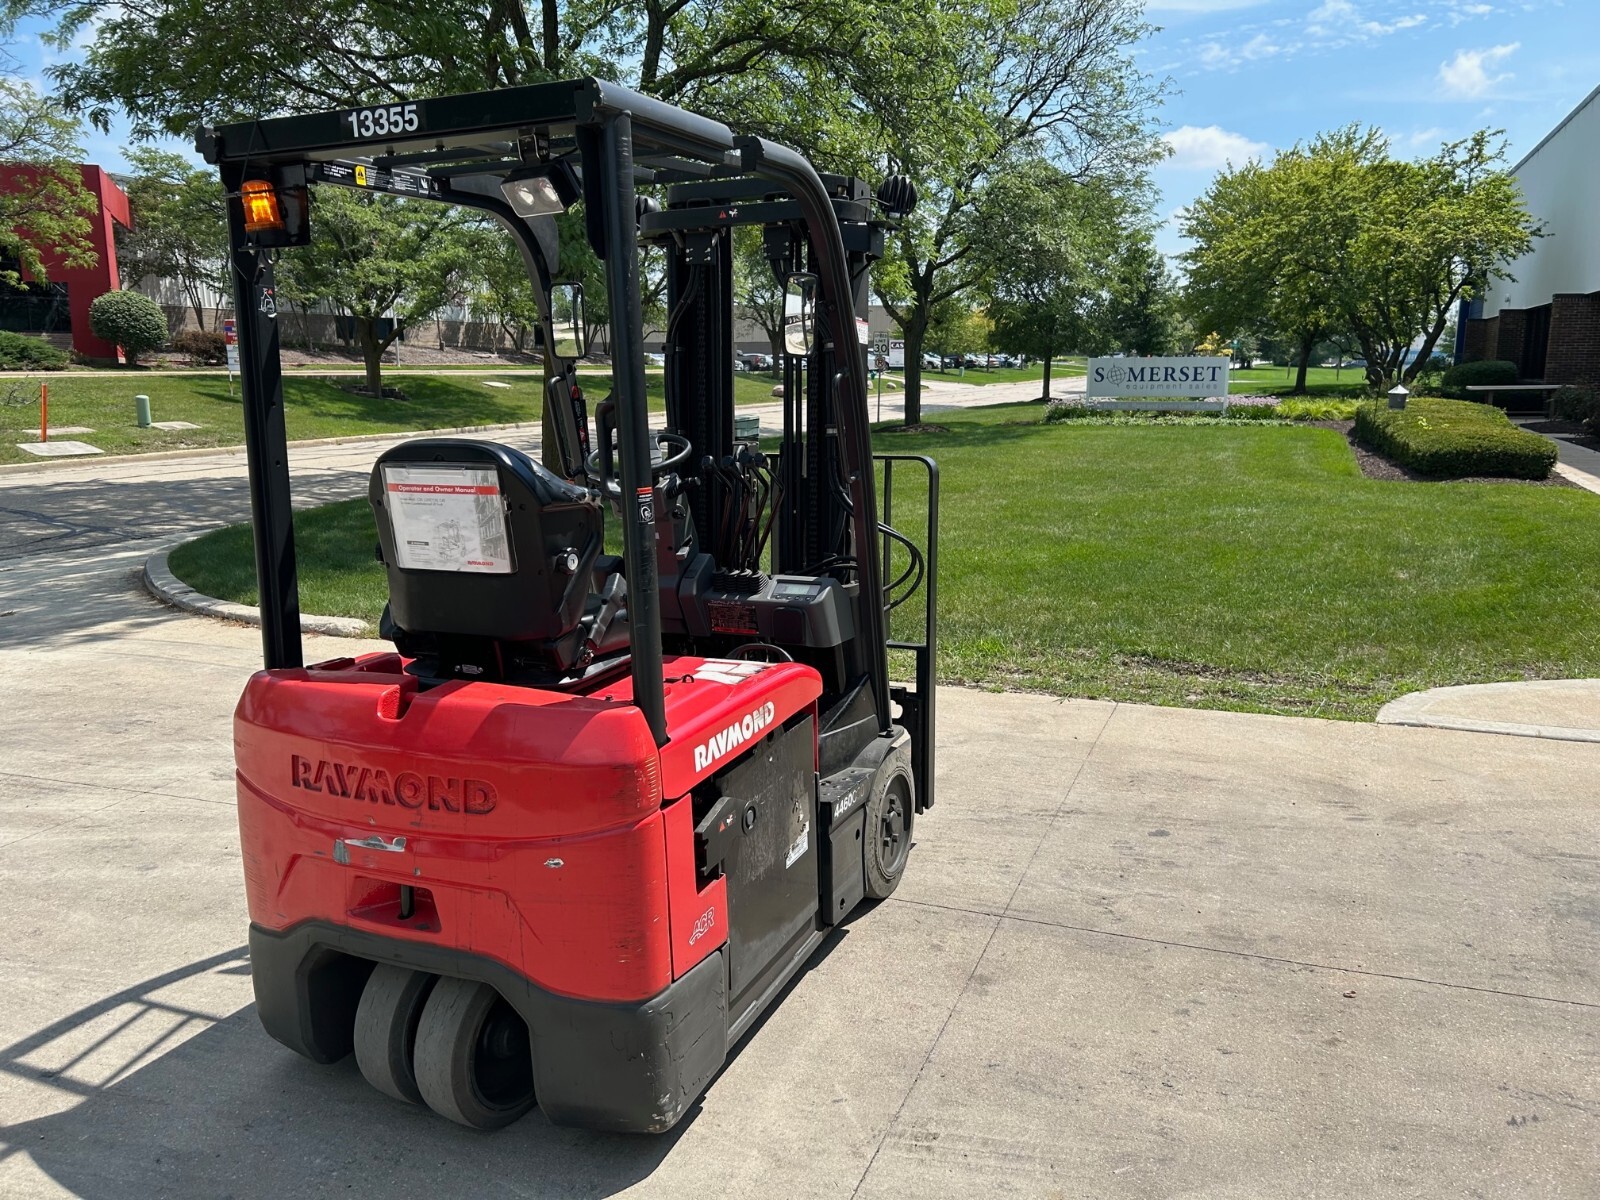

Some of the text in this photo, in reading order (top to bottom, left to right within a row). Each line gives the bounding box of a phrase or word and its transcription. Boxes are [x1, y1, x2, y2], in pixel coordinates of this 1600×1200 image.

[348, 104, 419, 138] 13355
[874, 344, 888, 353] 30
[1094, 366, 1221, 383] SOMERSET
[398, 485, 422, 493] Operator
[694, 701, 775, 773] RAYMOND
[291, 754, 497, 815] RAYMOND
[689, 906, 715, 946] ACR
